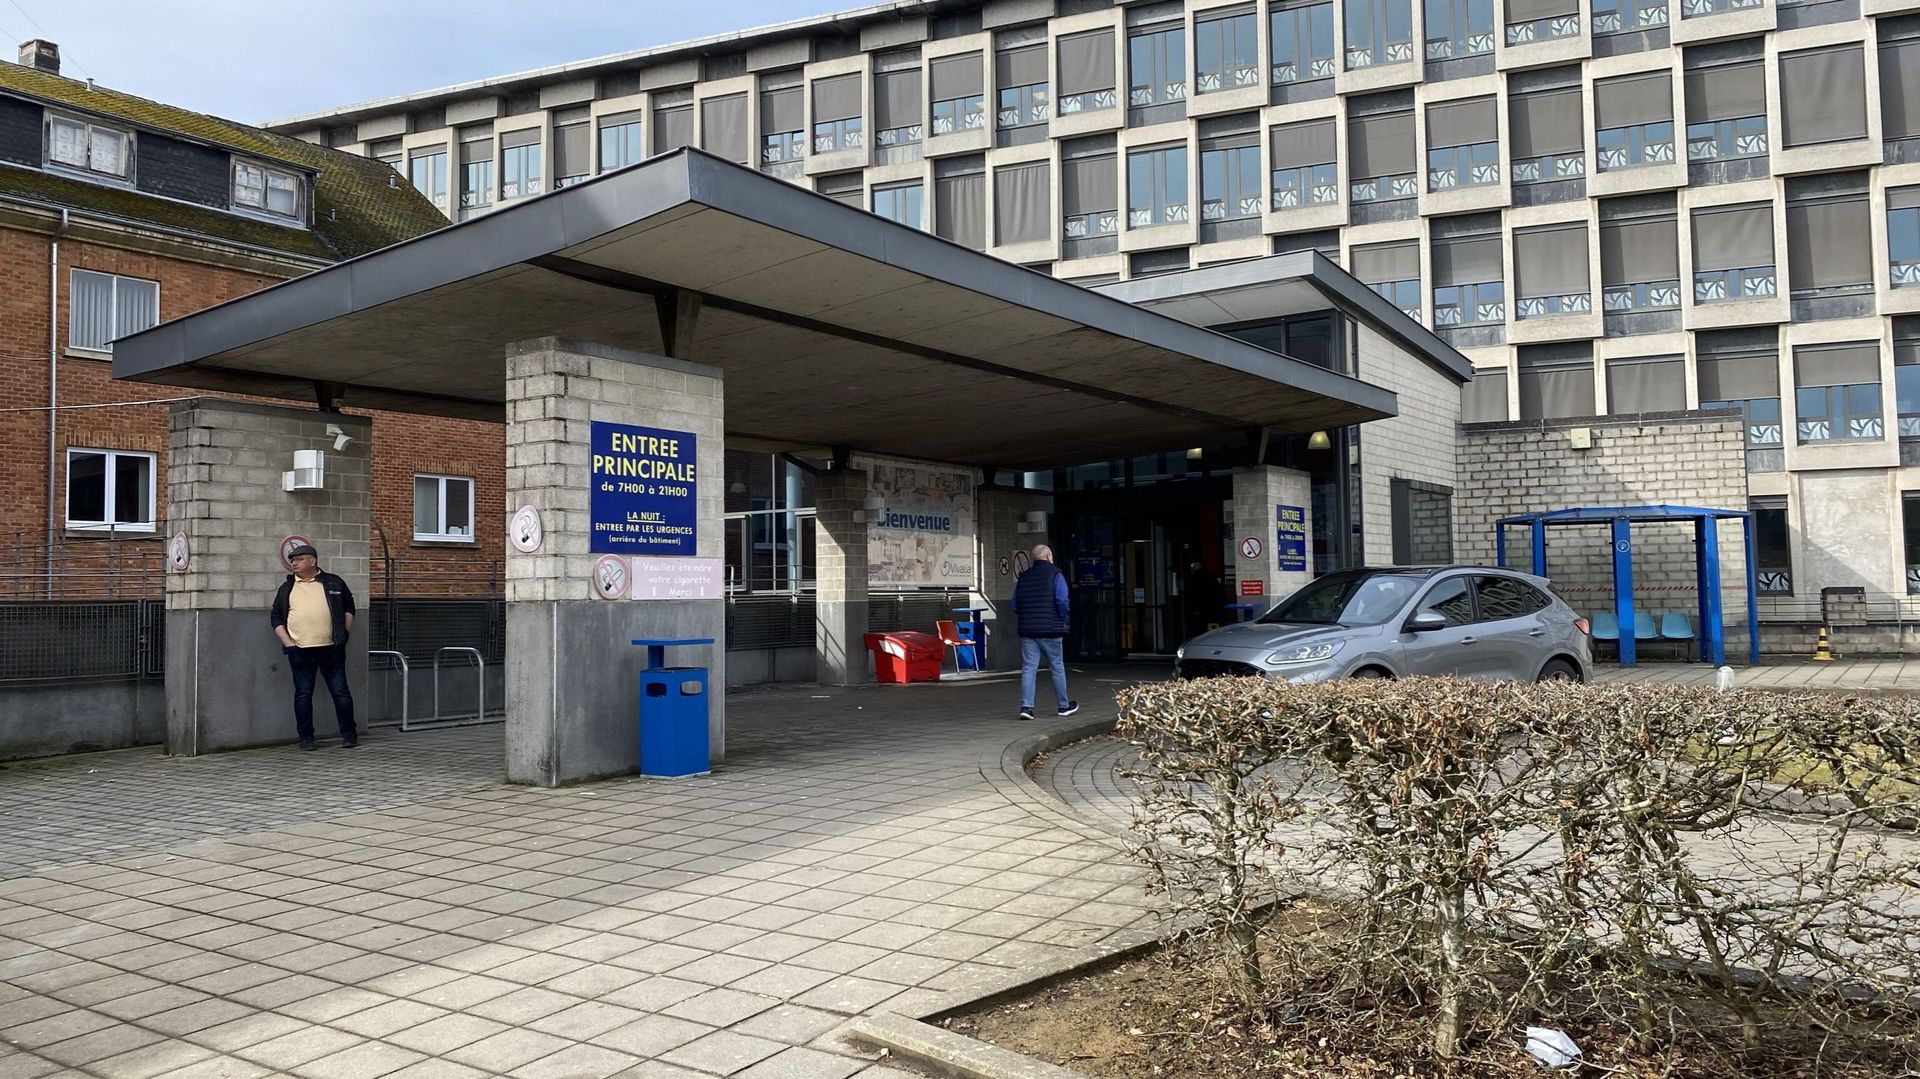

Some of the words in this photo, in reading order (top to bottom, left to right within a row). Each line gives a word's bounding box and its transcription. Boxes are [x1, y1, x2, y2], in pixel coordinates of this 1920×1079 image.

[611, 432, 679, 458] ENTREE
[593, 454, 695, 482] PRINCIPALE
[601, 481, 614, 492] de
[618, 482, 645, 494] 7H00
[648, 484, 655, 495] à
[658, 485, 688, 497] 21H00
[627, 511, 638, 520] LA
[640, 512, 660, 521] NUIT
[877, 507, 951, 531] ienvenue
[1282, 509, 1300, 520] ENTREE
[595, 523, 624, 532] ENTREE
[626, 524, 640, 533] PAR
[642, 525, 654, 533] LES
[656, 525, 693, 535] URGENCES
[1277, 521, 1305, 532] PRINCIPALE
[608, 534, 636, 543] (arrière
[638, 535, 647, 543] du
[649, 535, 681, 545] bâtiment)
[643, 562, 676, 572] Veuillez
[678, 563, 712, 572] éteindre
[648, 576, 671, 584] votre
[674, 577, 712, 586] cigarette
[668, 587, 693, 596] Merci
